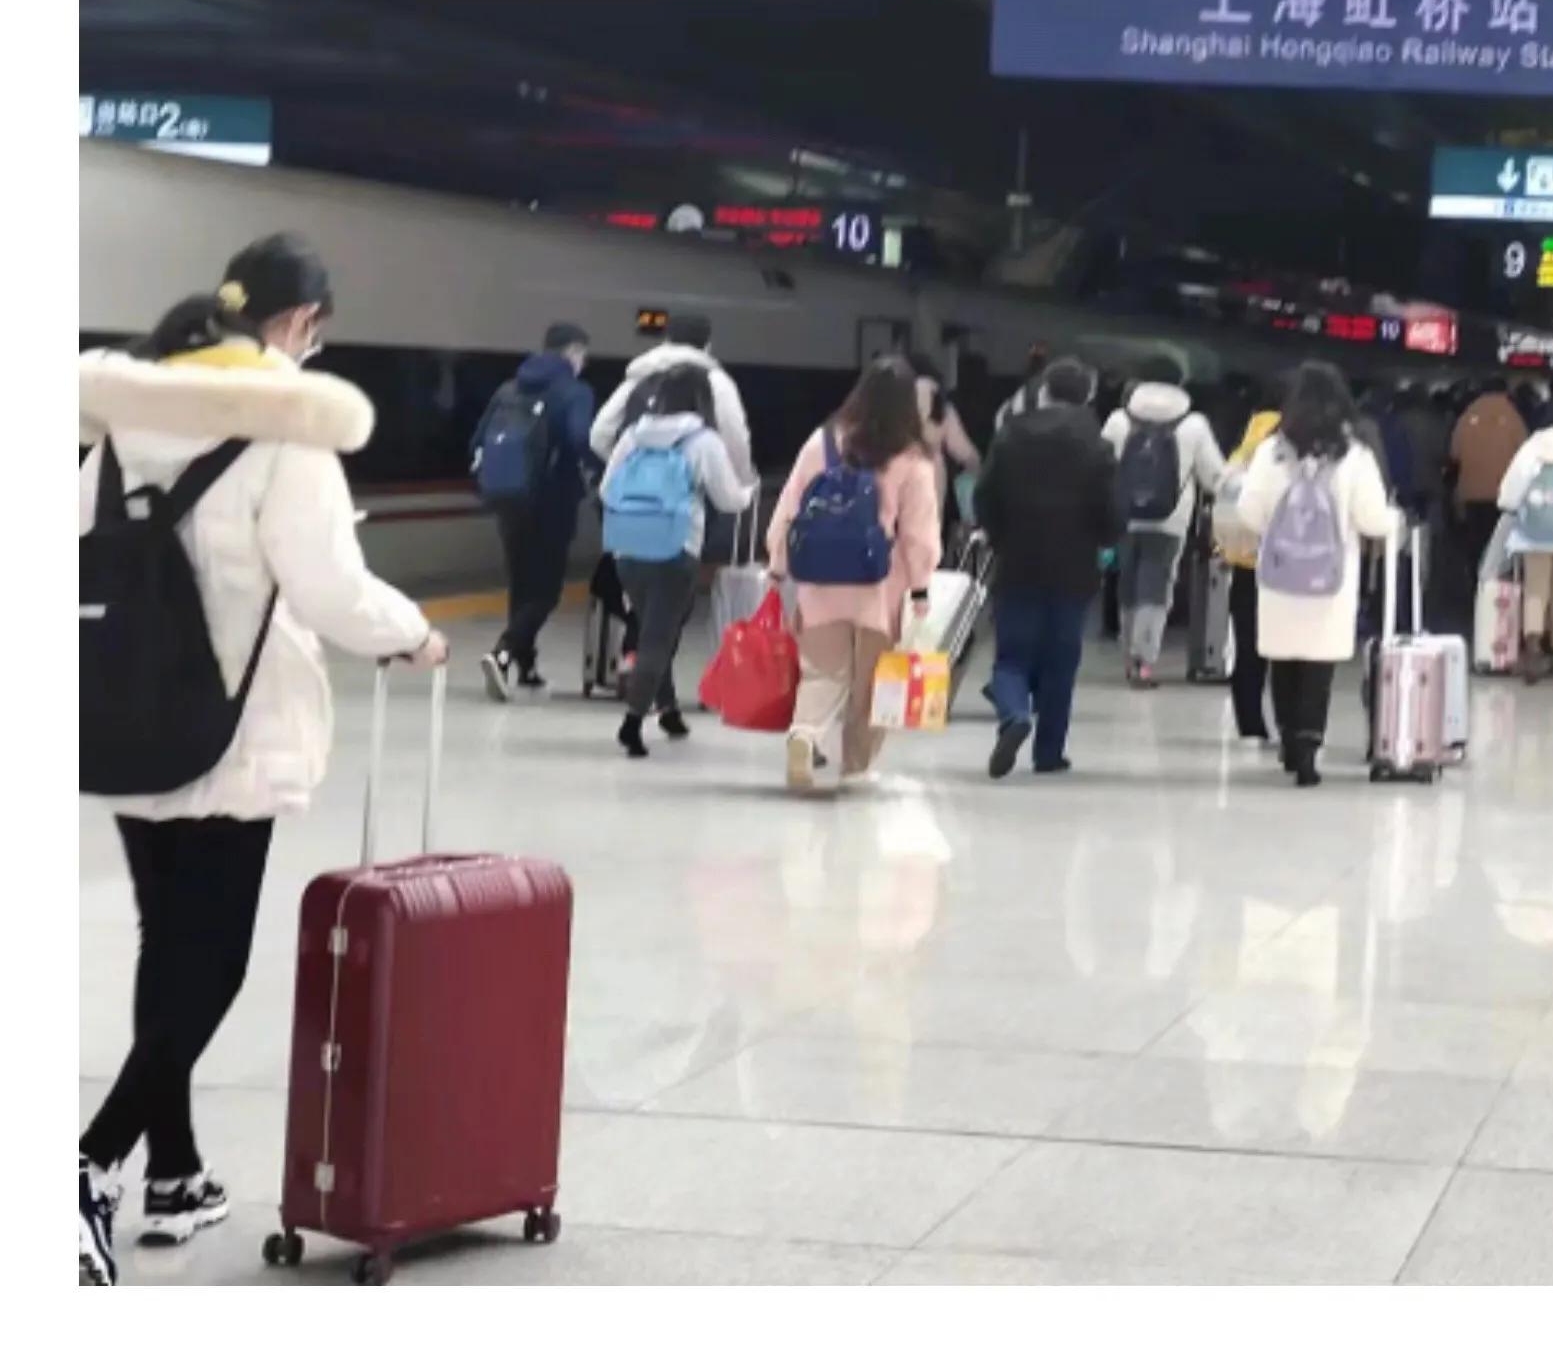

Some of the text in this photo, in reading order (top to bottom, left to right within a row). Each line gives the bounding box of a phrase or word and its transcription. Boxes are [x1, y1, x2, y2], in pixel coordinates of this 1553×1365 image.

[1120, 26, 1251, 62] Shanghai
[1260, 33, 1393, 66] Hongqiao
[1402, 37, 1511, 72] Railway
[831, 213, 870, 251] 10
[1504, 240, 1526, 278] 9
